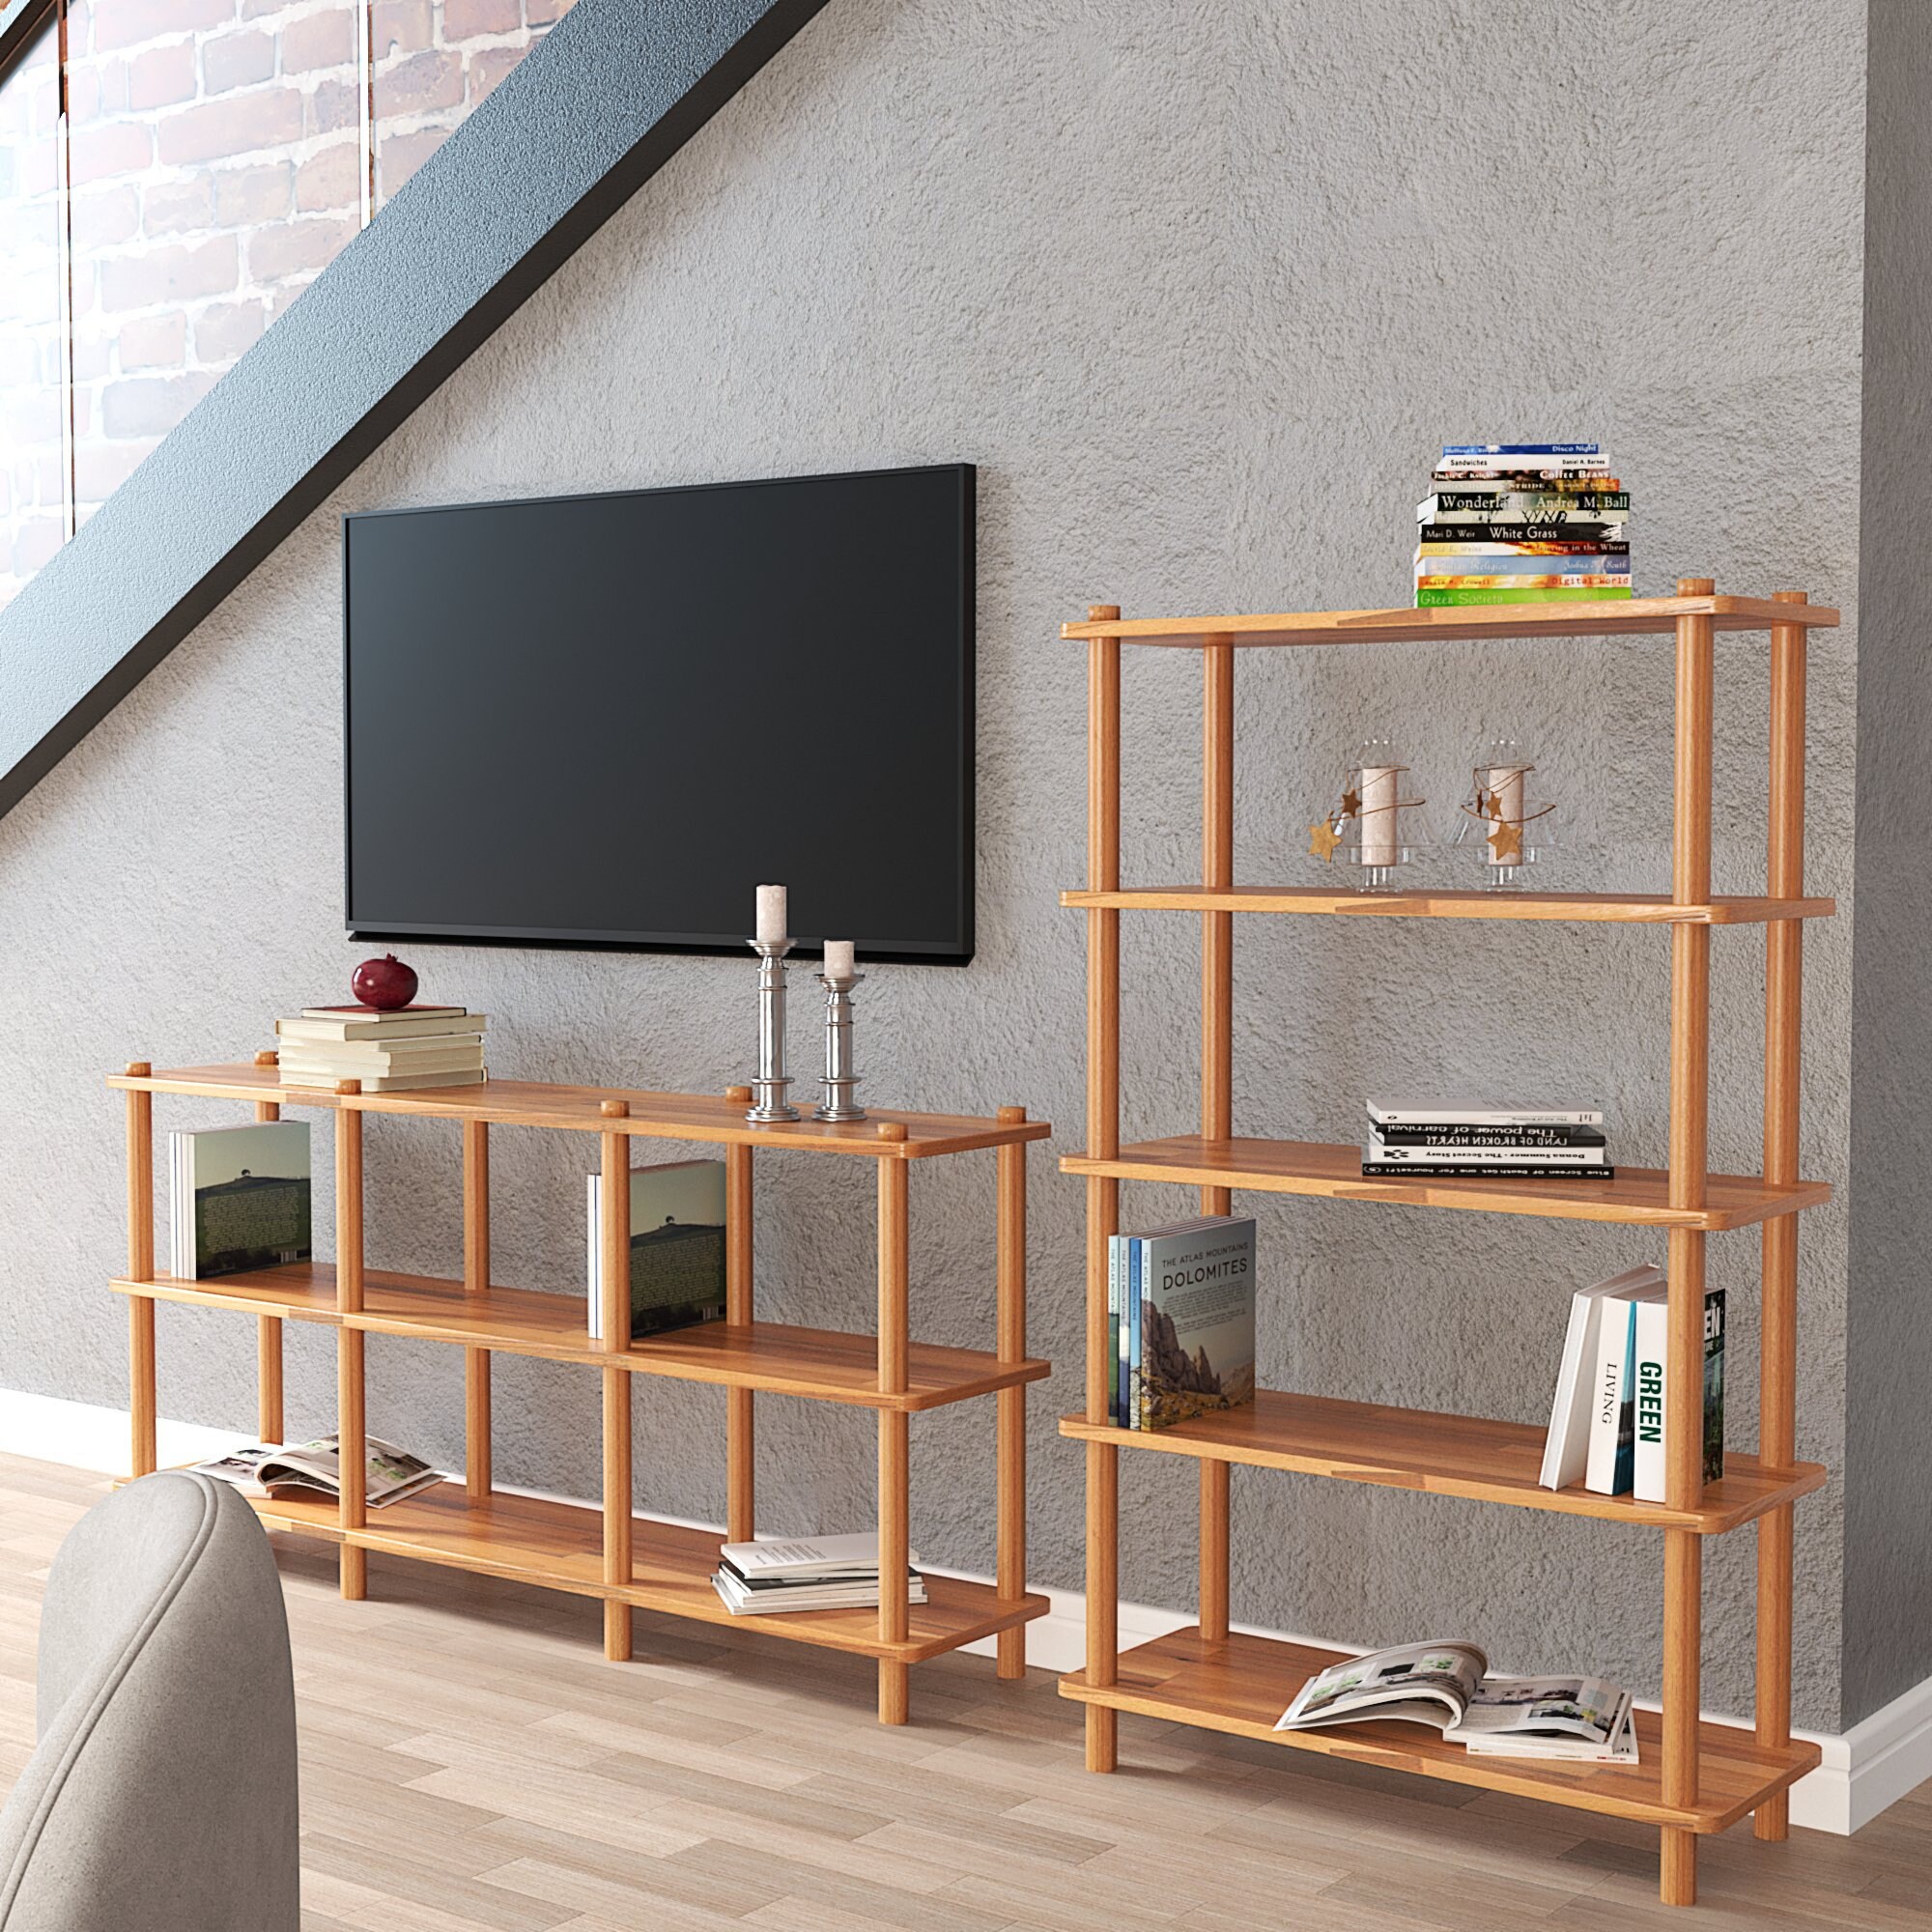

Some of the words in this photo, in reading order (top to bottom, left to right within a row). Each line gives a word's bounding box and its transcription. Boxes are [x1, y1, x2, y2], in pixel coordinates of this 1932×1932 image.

[1441, 496, 1524, 508] Wonderland
[1537, 497, 1579, 508] Andrea
[1583, 496, 1599, 508] M.
[1605, 496, 1627, 508] Ball
[1426, 529, 1444, 538] Mari
[1445, 528, 1455, 538] D.
[1458, 529, 1475, 538] Weir
[1490, 527, 1522, 539] White
[1526, 526, 1557, 539] Grass
[1421, 593, 1454, 605] Green
[1387, 1124, 1448, 1133] carnival
[1451, 1126, 1469, 1135] of
[1474, 1125, 1522, 1136] power
[1527, 1127, 1556, 1137] The
[1162, 1257, 1177, 1268] THE
[1179, 1252, 1203, 1264] ATLAS
[1207, 1241, 1248, 1259] MOUNTAINS
[1163, 1259, 1247, 1291] DOLOMITES
[1602, 1363, 1617, 1424] LIVING
[1639, 1361, 1662, 1443] GREEN
